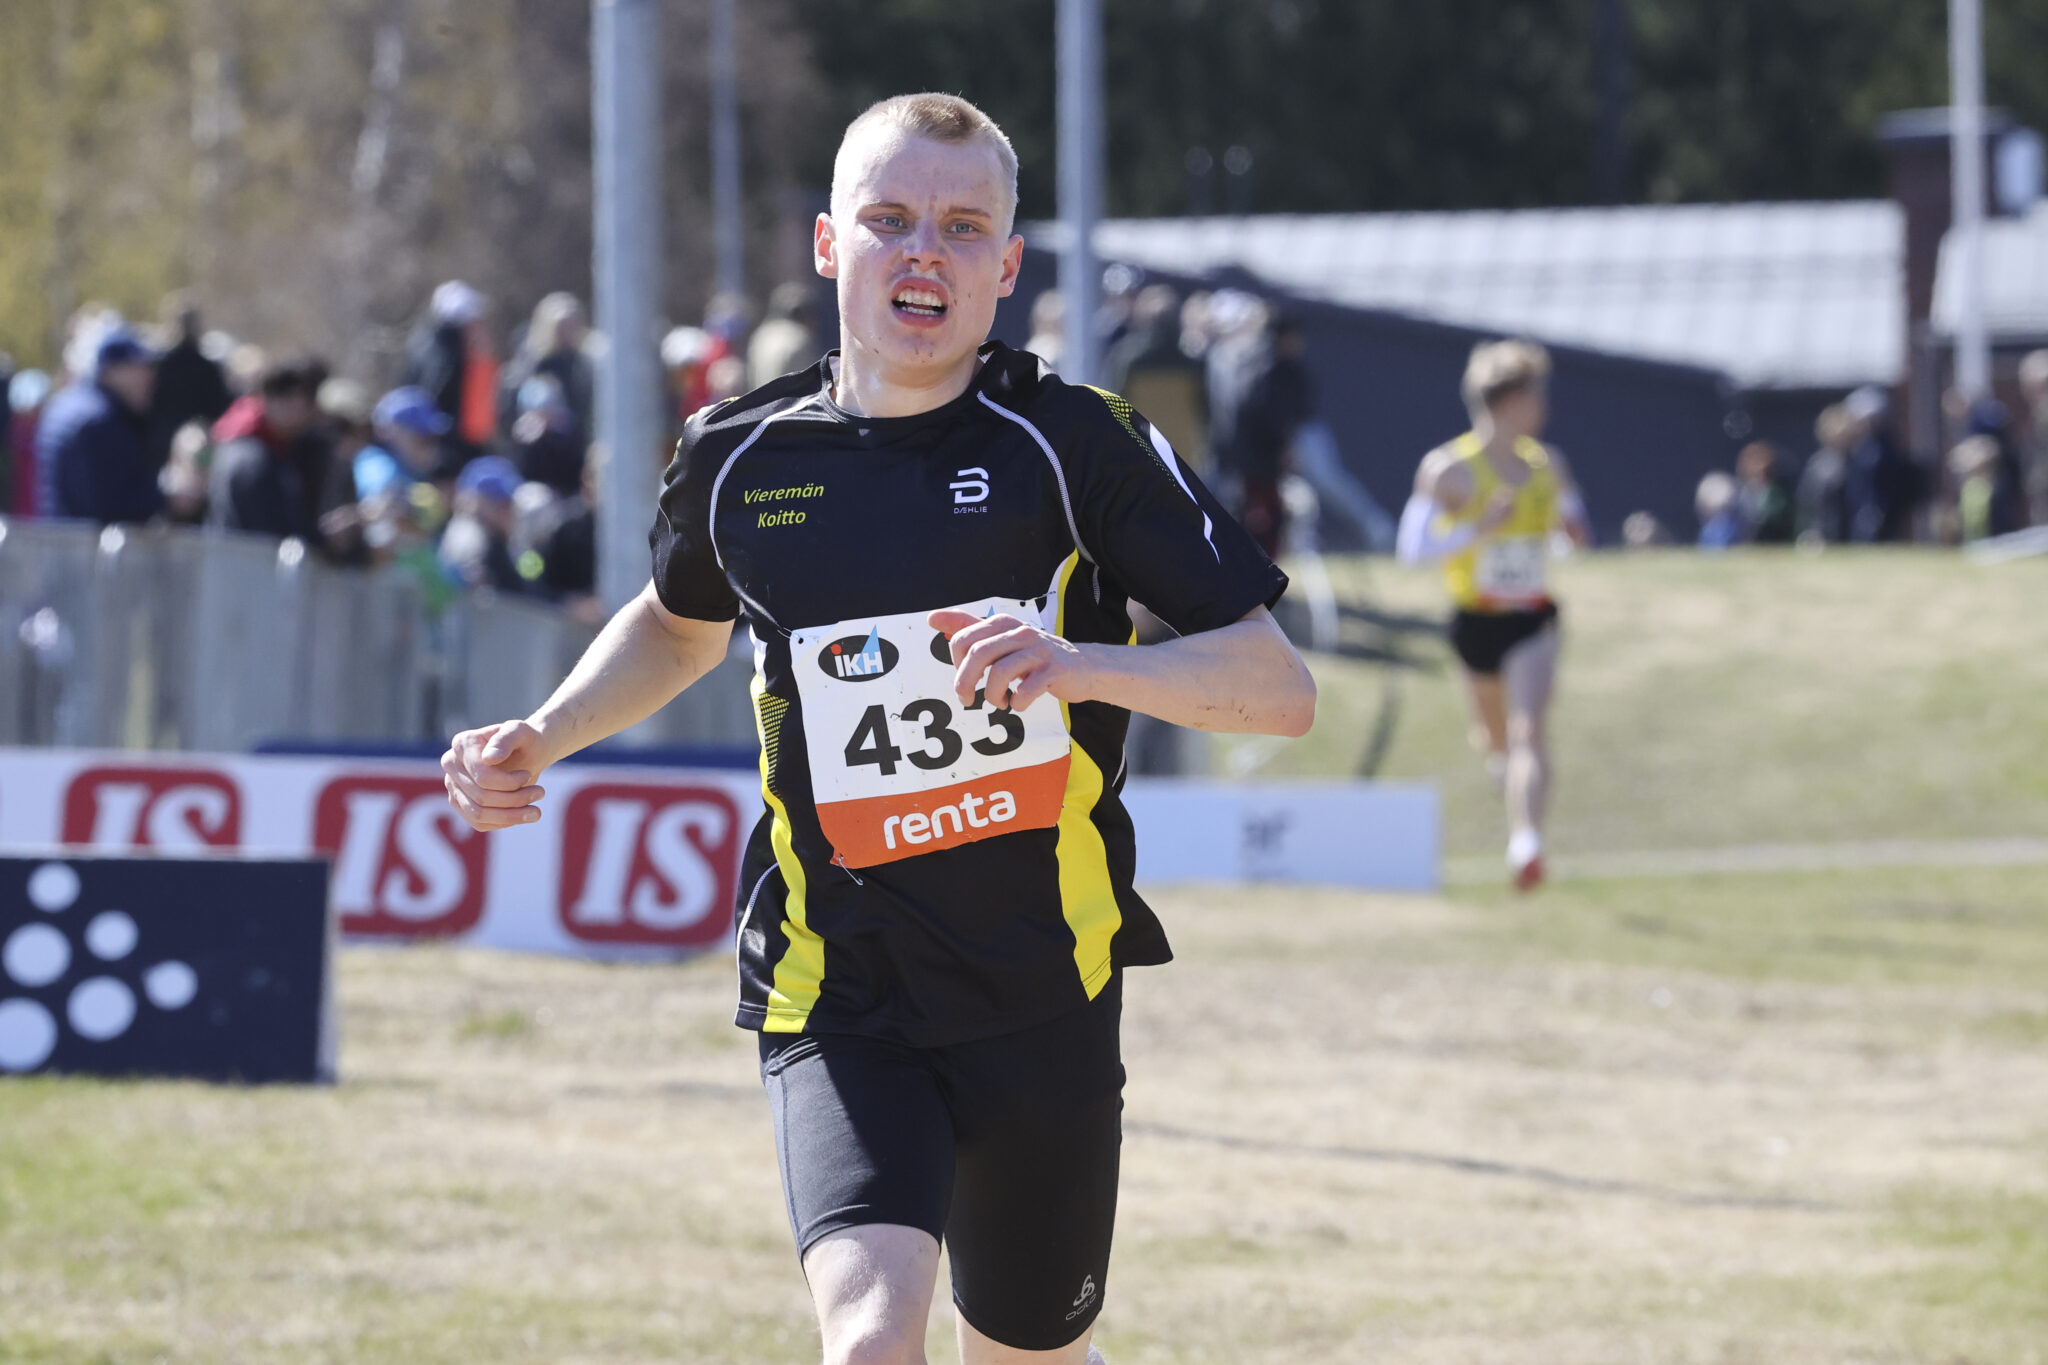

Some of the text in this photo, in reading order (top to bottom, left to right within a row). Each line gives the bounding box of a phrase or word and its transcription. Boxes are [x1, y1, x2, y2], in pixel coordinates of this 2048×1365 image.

[743, 483, 825, 504] Vieremän
[757, 509, 807, 529] Koitto
[843, 687, 1026, 776] 433
[335, 790, 477, 922] IS
[883, 790, 1017, 850] renta
[570, 797, 732, 929] IS
